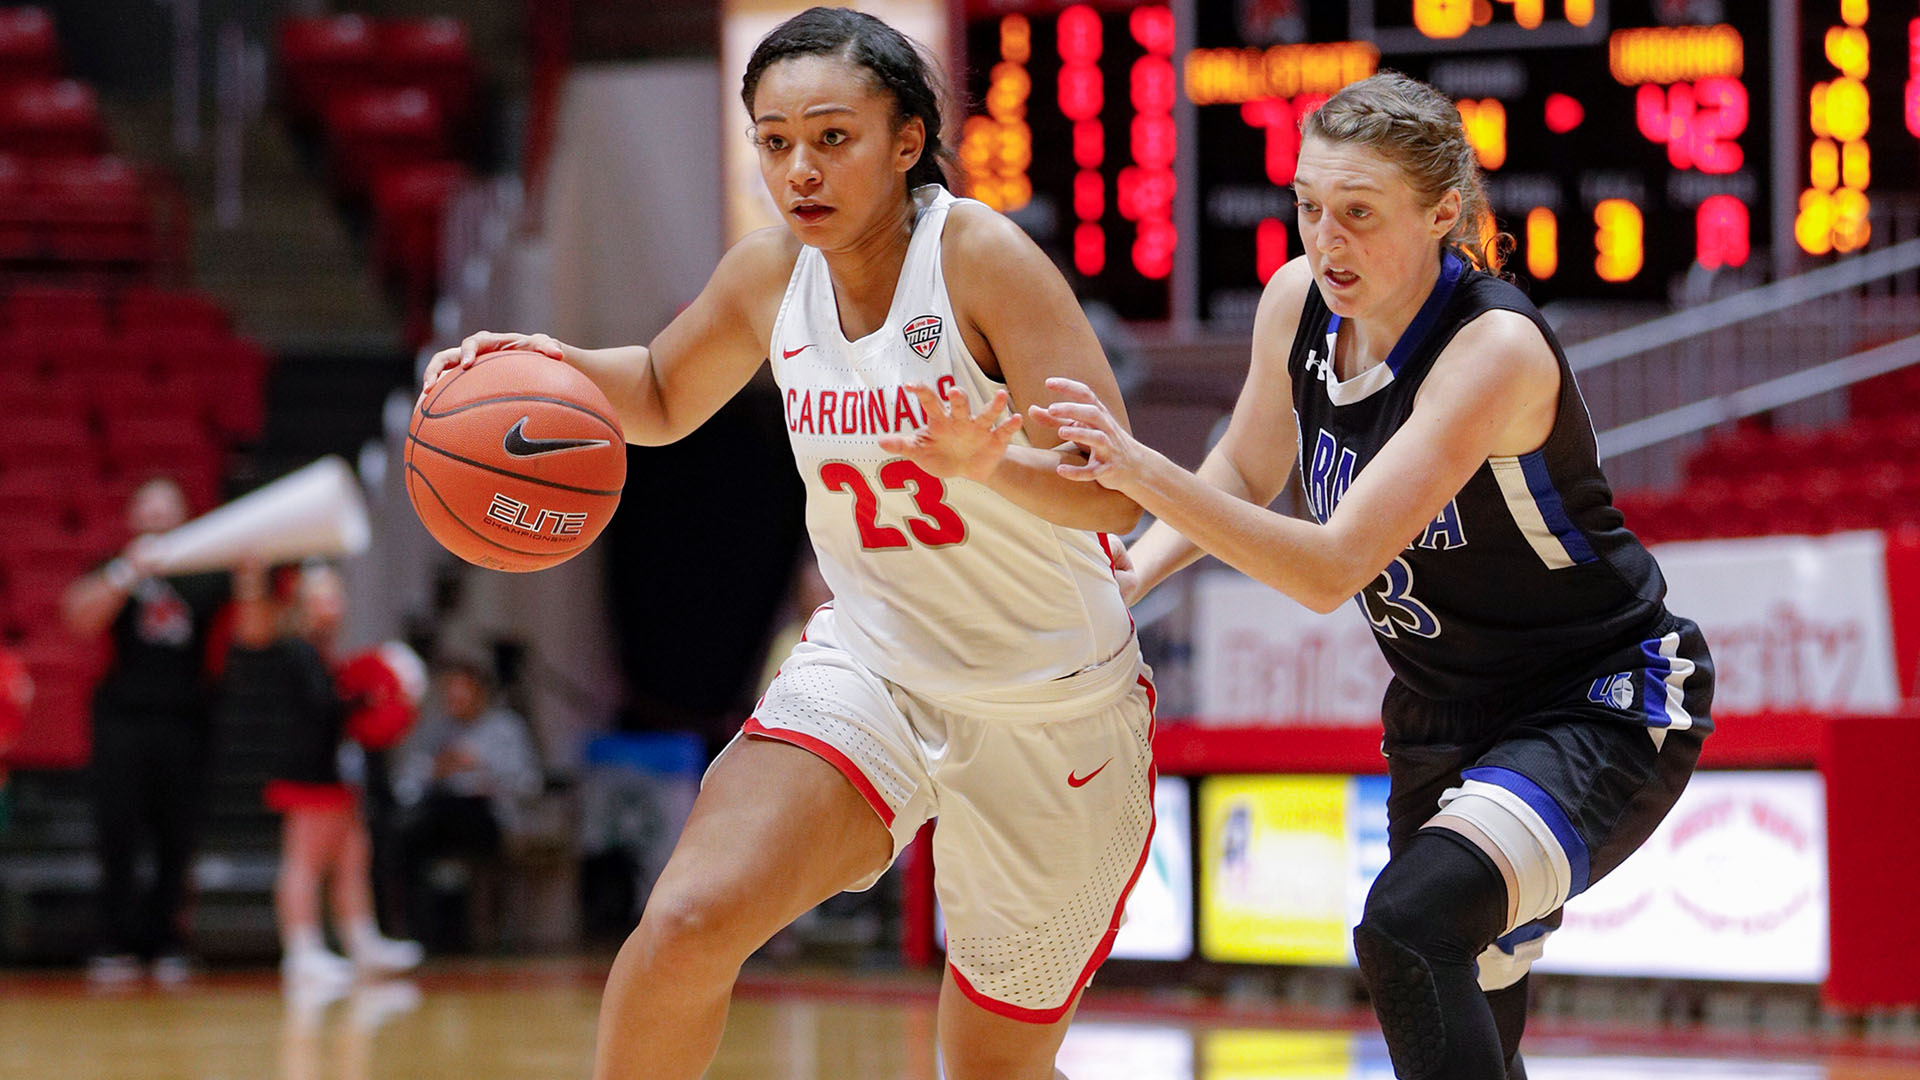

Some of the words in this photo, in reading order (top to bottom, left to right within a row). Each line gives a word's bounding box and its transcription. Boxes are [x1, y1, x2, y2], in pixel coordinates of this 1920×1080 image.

[906, 324, 942, 345] MAC
[487, 492, 588, 535] ELITE
[818, 457, 969, 552] 23
[483, 517, 577, 543] CHAMPIONSHIP
